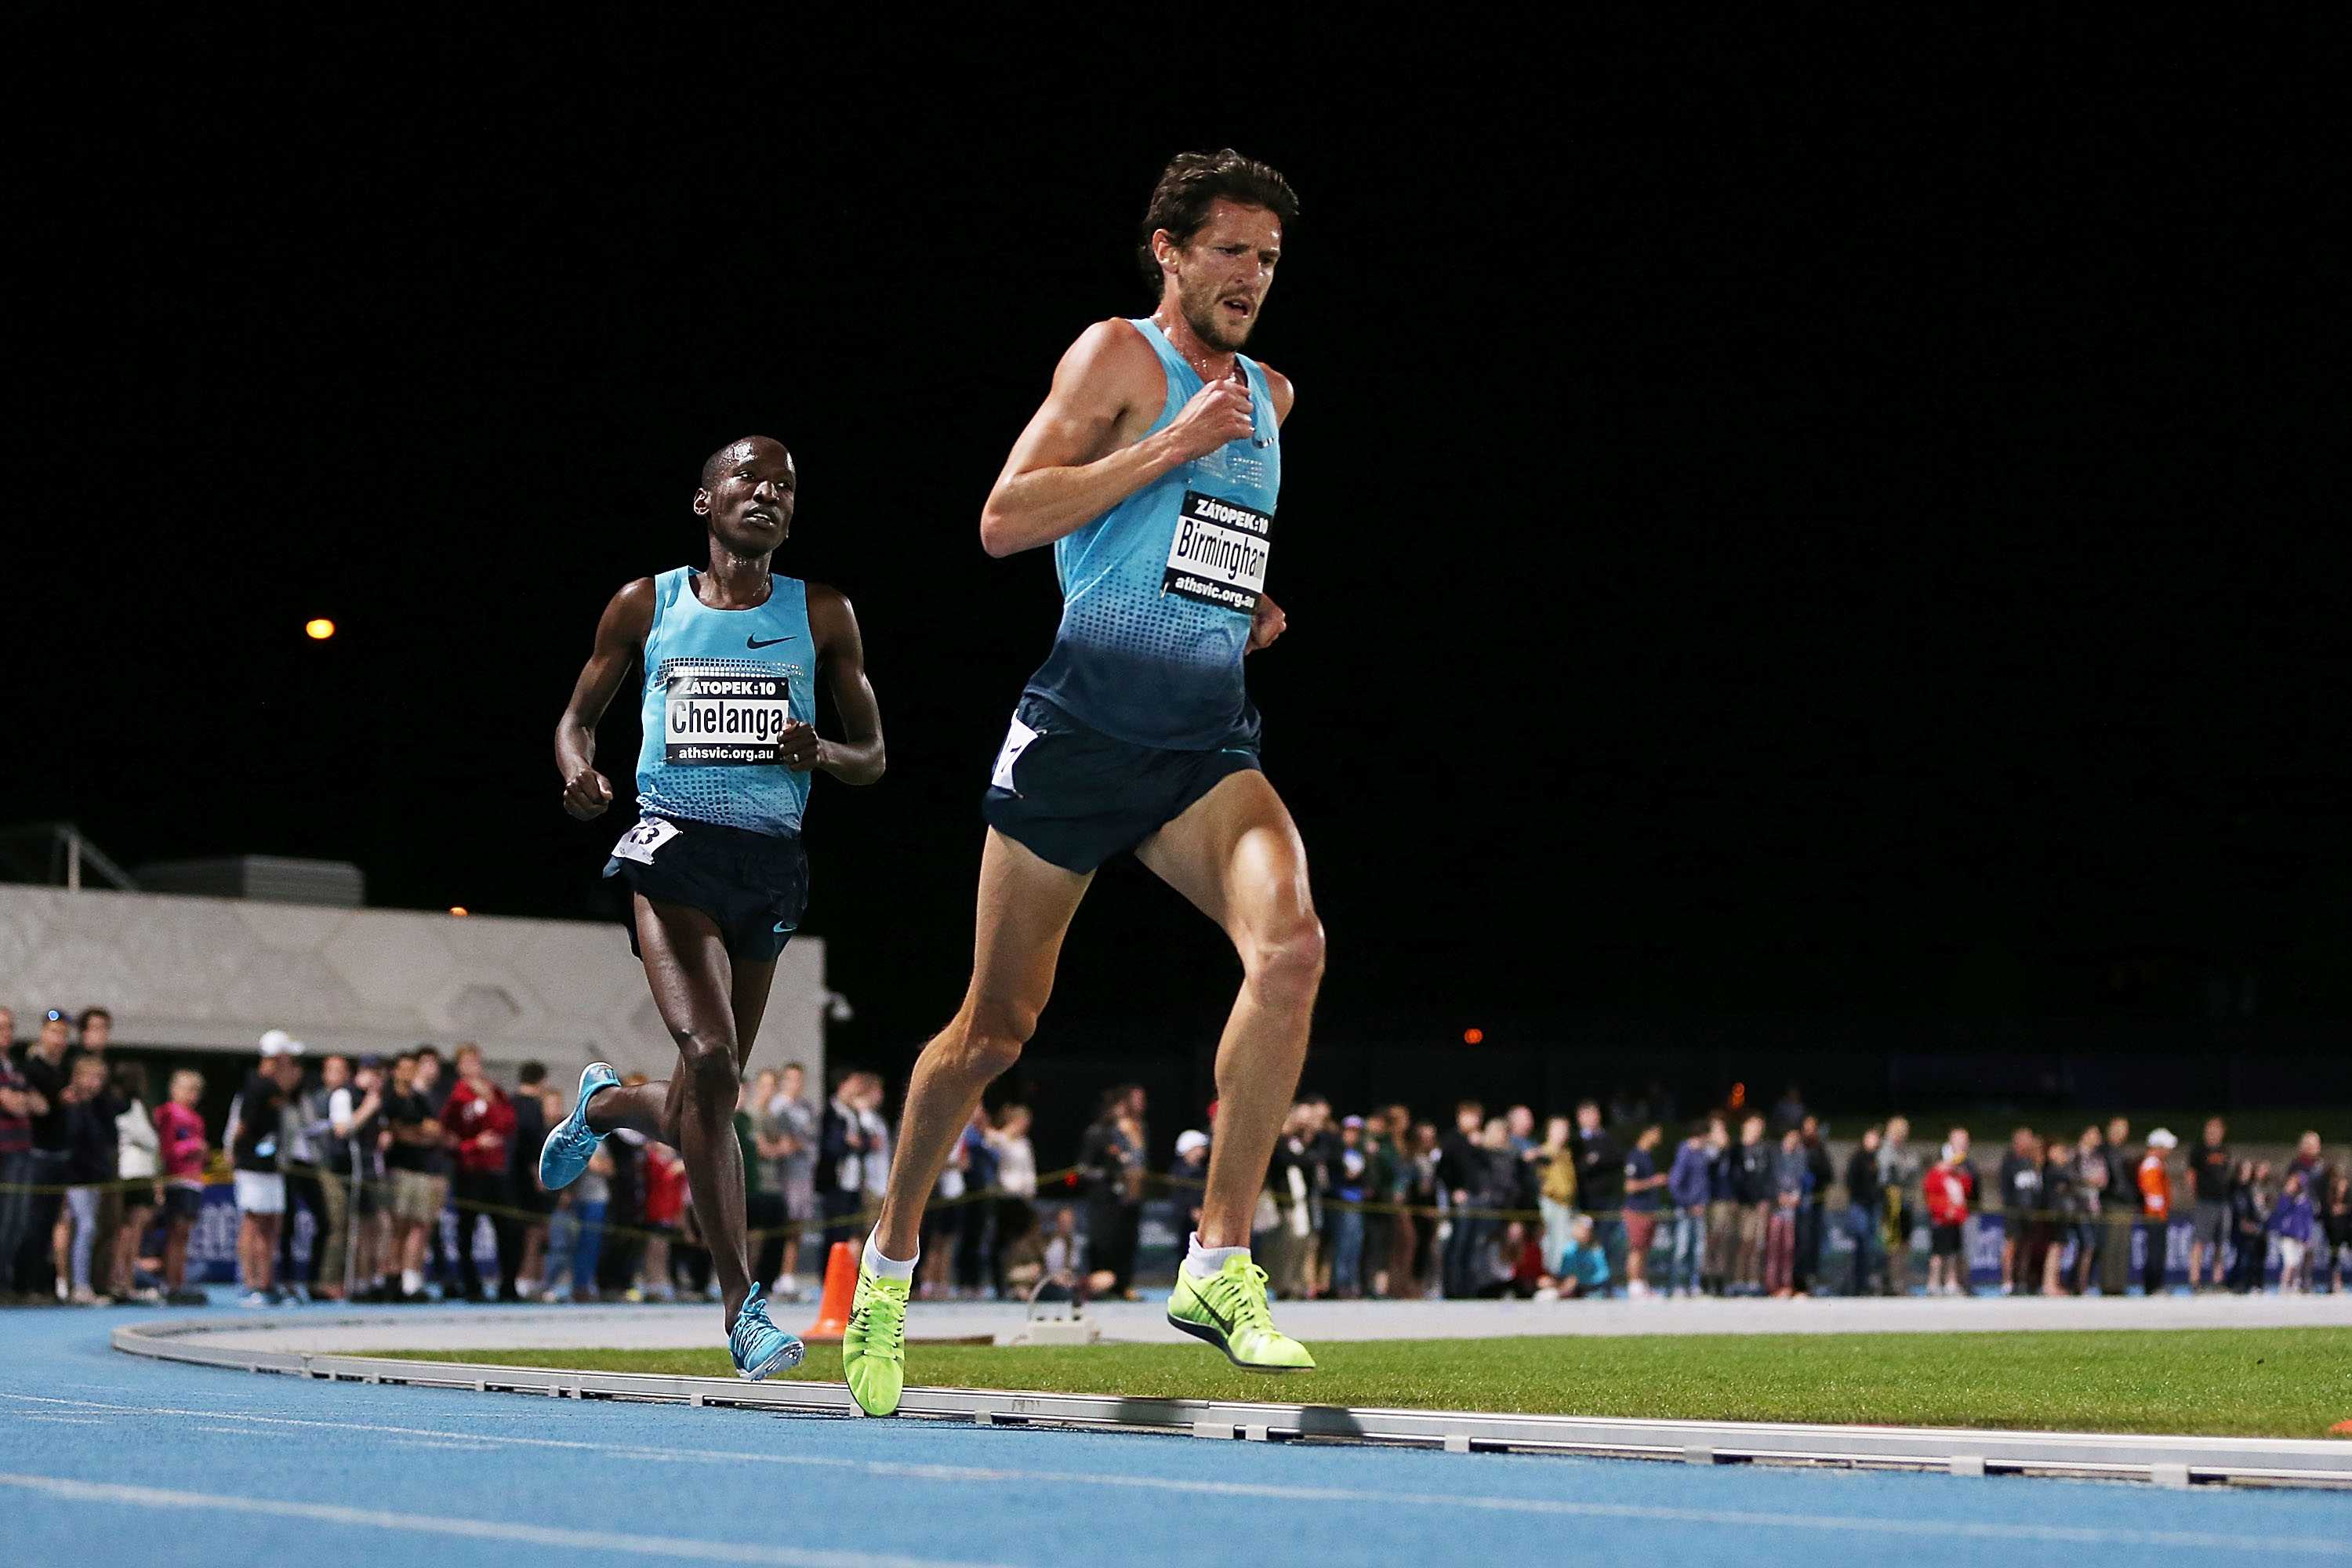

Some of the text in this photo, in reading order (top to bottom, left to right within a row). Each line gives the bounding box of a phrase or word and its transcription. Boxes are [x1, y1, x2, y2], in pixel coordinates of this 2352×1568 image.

[1178, 520, 1265, 580] Birmingha
[672, 701, 783, 742] Chelanga
[679, 747, 774, 761] athsvic.org.au
